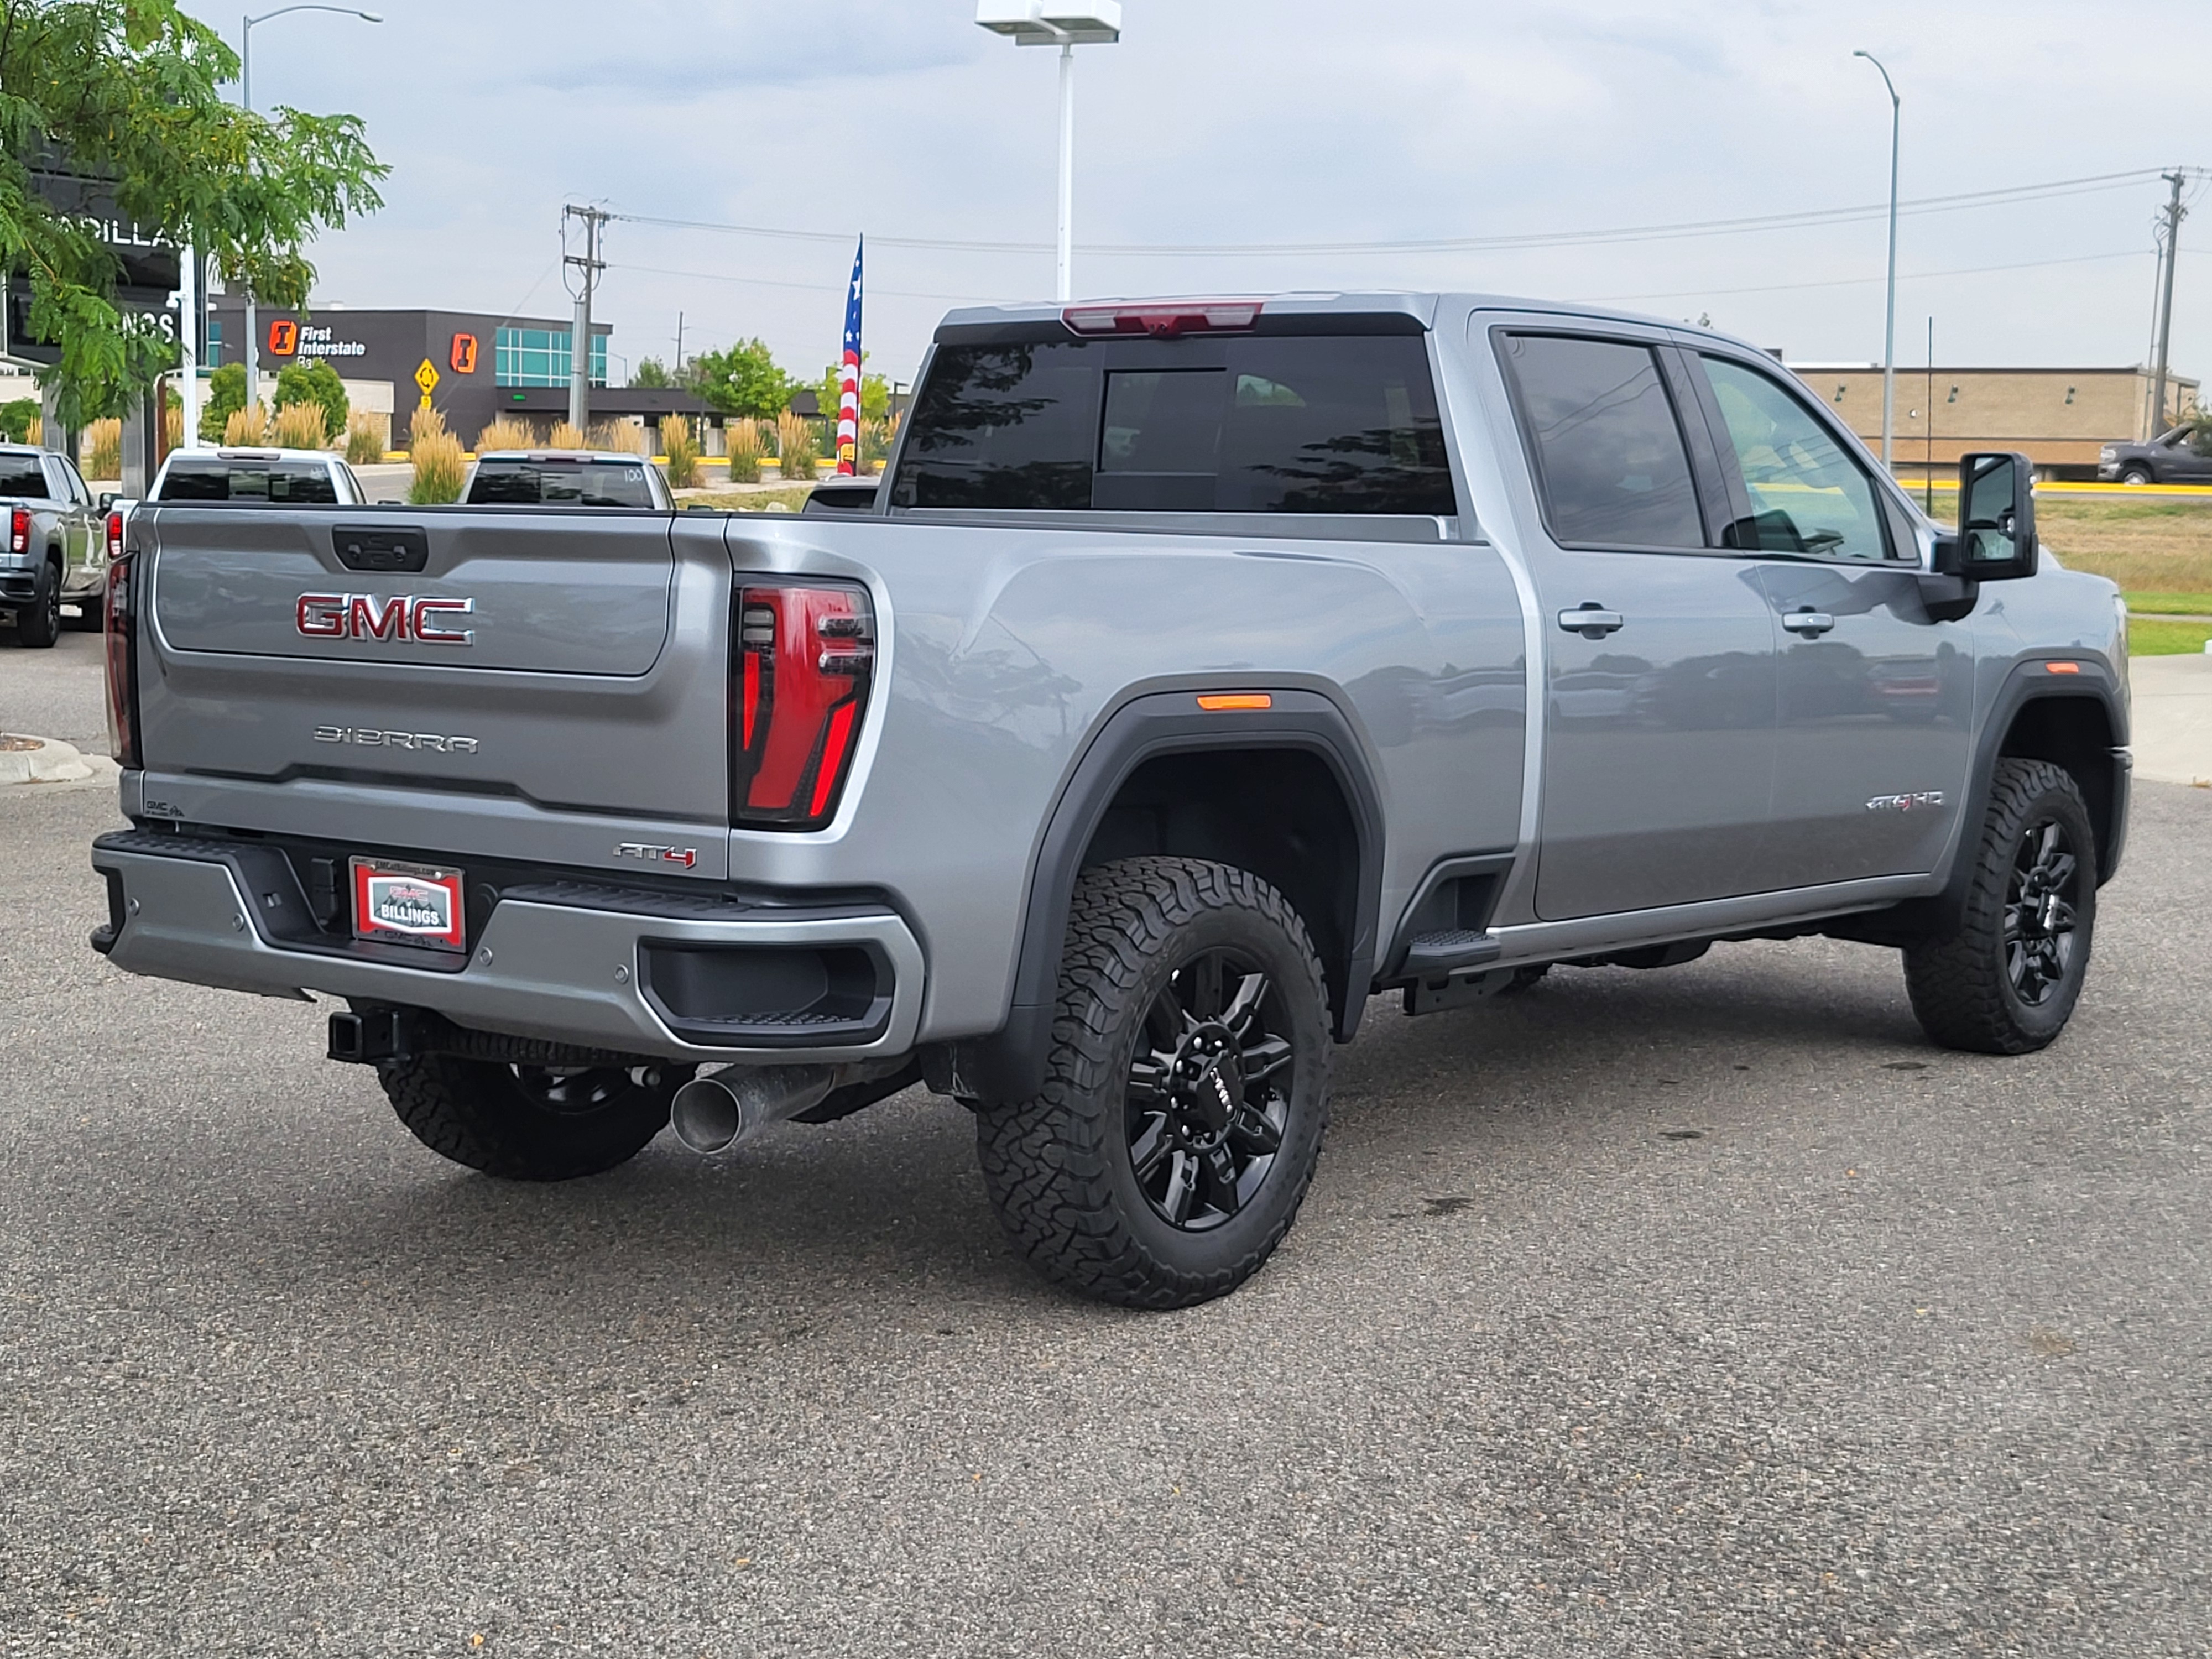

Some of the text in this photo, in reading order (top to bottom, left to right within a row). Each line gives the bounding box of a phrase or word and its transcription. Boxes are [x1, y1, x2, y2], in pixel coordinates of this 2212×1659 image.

[299, 326, 332, 341] First
[298, 341, 366, 356] Interstate
[624, 468, 643, 482] 100
[295, 592, 475, 646] GMC
[313, 726, 478, 754] SIERRA
[612, 842, 697, 870] AT4
[389, 886, 429, 901] GMC
[380, 903, 440, 925] BILLINGS
